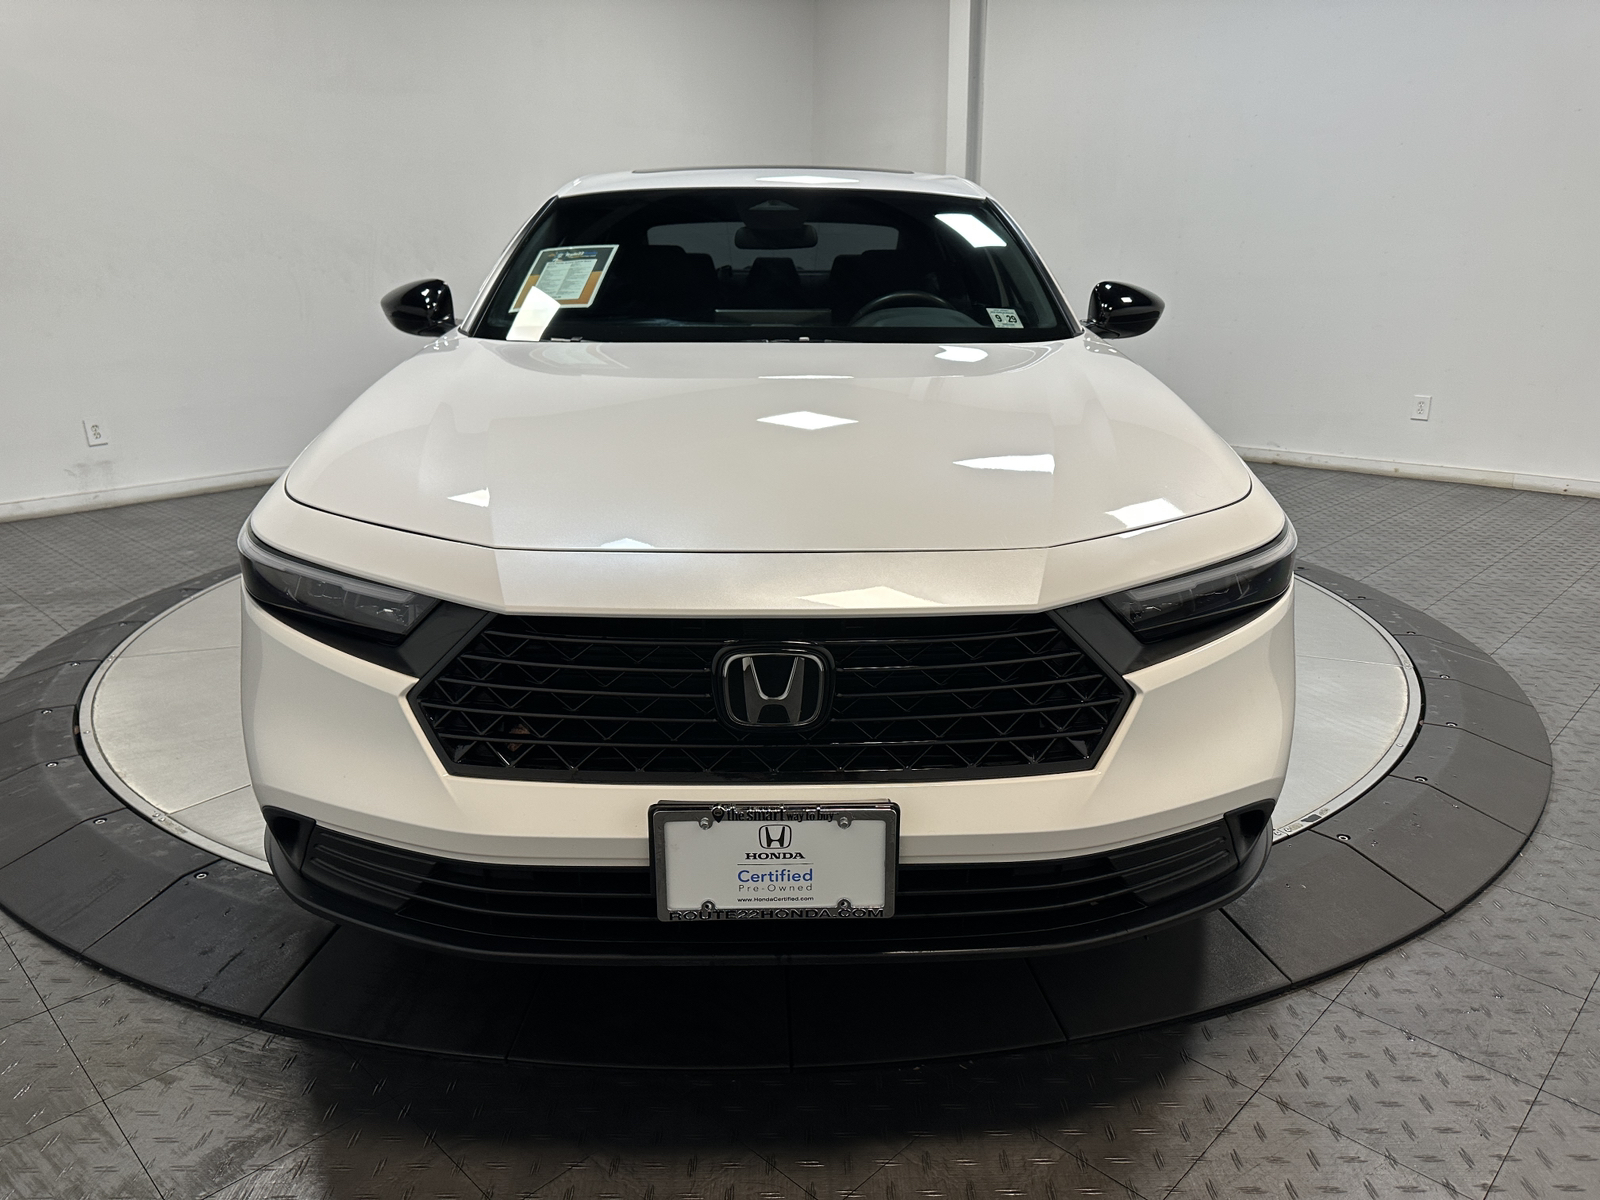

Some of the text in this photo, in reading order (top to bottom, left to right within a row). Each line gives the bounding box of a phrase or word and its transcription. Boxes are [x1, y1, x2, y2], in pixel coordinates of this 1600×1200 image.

[995, 314, 1018, 323] 9 29
[727, 807, 834, 823] the smart way to buy
[744, 852, 806, 860] HONDA
[737, 867, 813, 883] Certified
[738, 882, 813, 893] Pre-Owned
[669, 909, 884, 921] ROUTE22HONDA.COM
